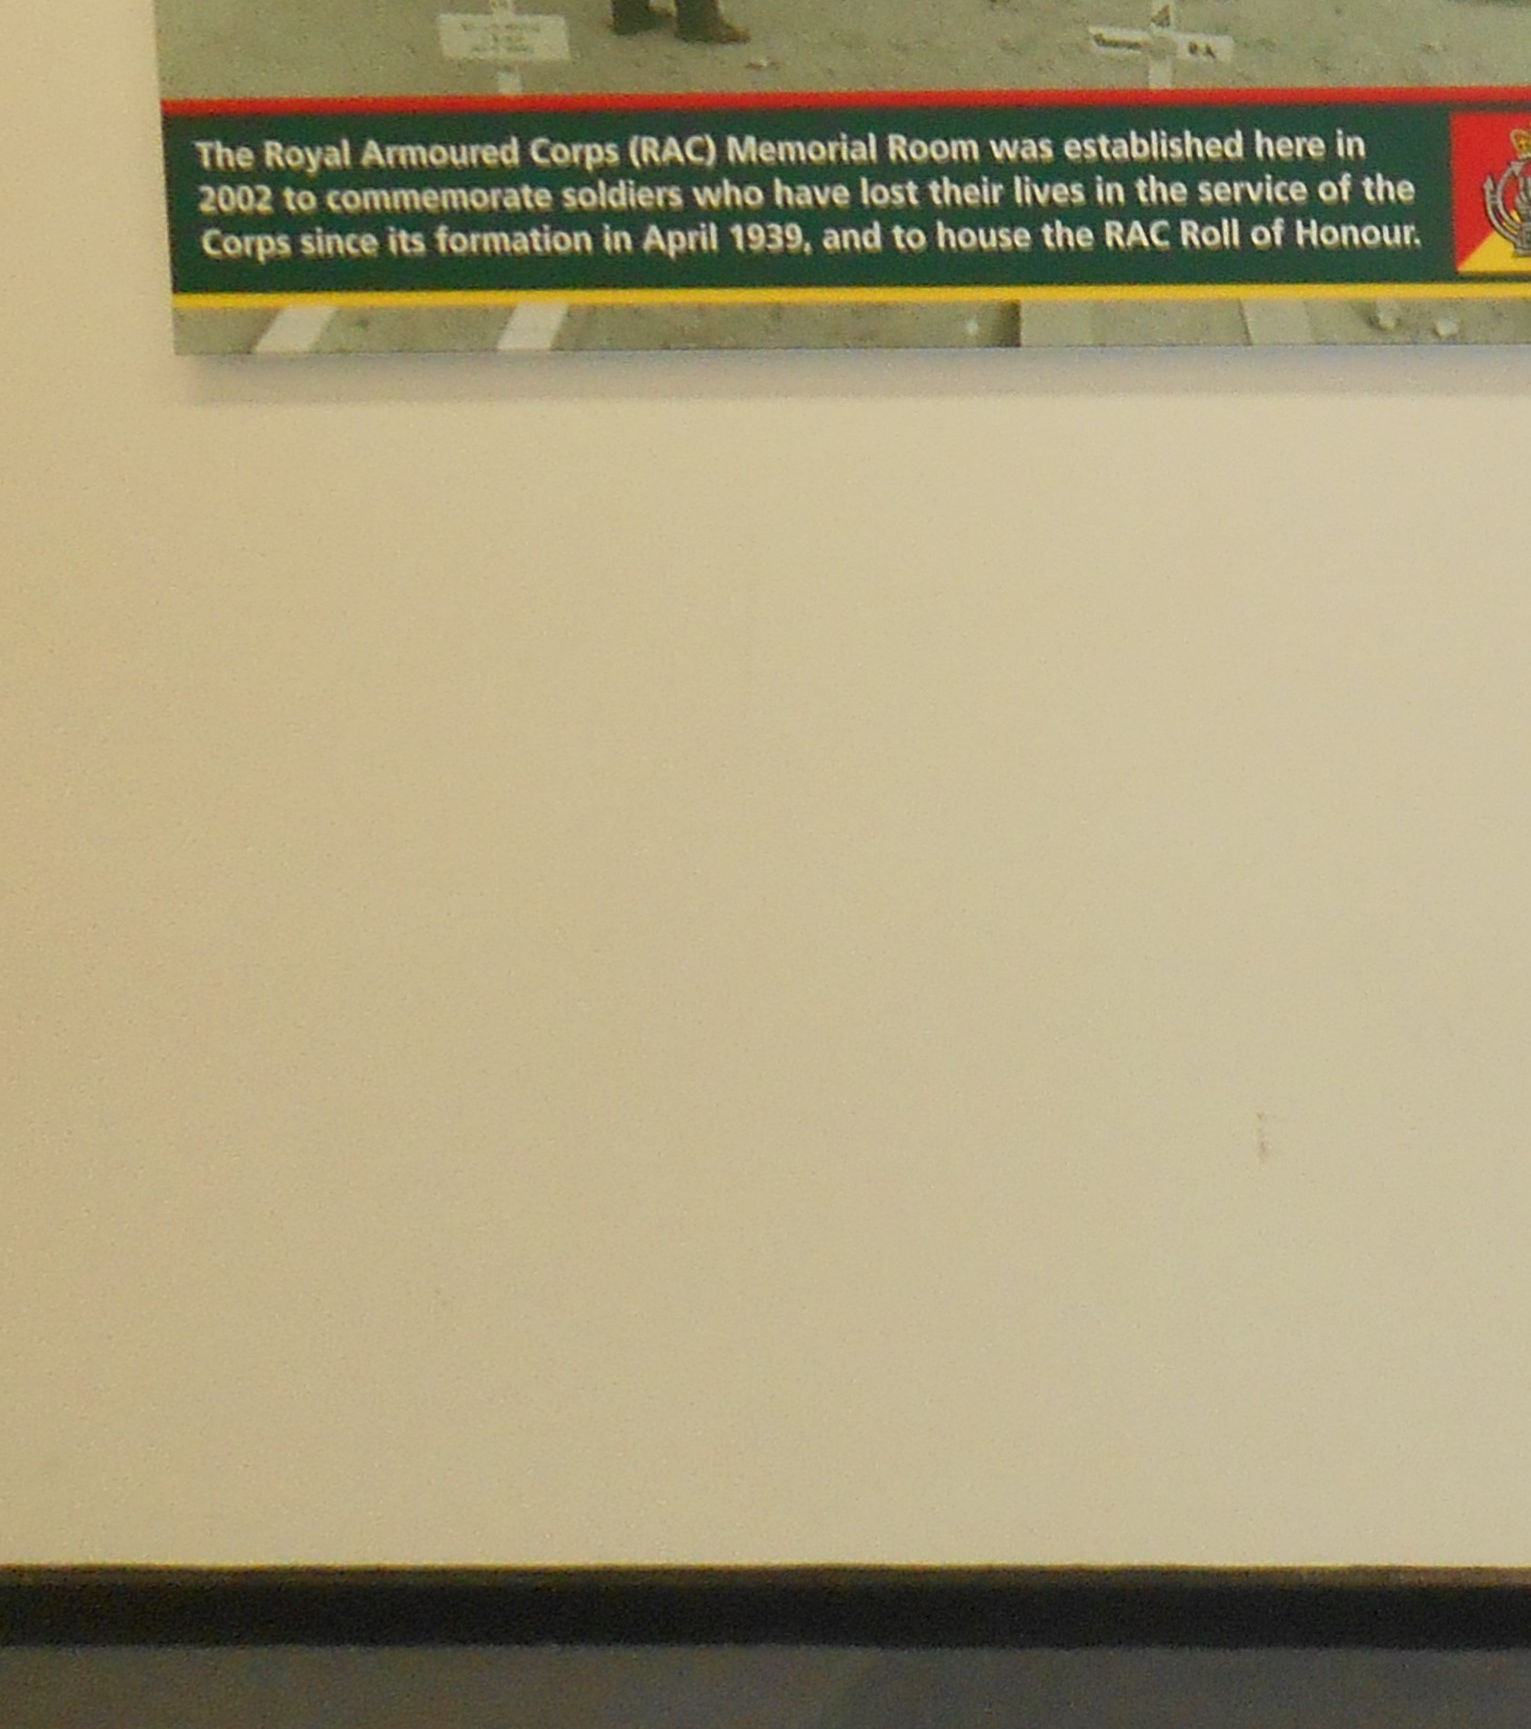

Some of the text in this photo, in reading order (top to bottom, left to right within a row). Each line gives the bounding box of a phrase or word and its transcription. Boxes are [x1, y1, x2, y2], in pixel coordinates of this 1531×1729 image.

[194, 128, 1366, 177] The Royal Armoured Corps (RAC) Memorial Room was established here in
[198, 171, 1416, 215] 2002 to commemorate soldiers who have lost their lives in the service of the
[201, 216, 1421, 264] Corps since its formation in April 1939, and to house the RAC Roll of Honour.
